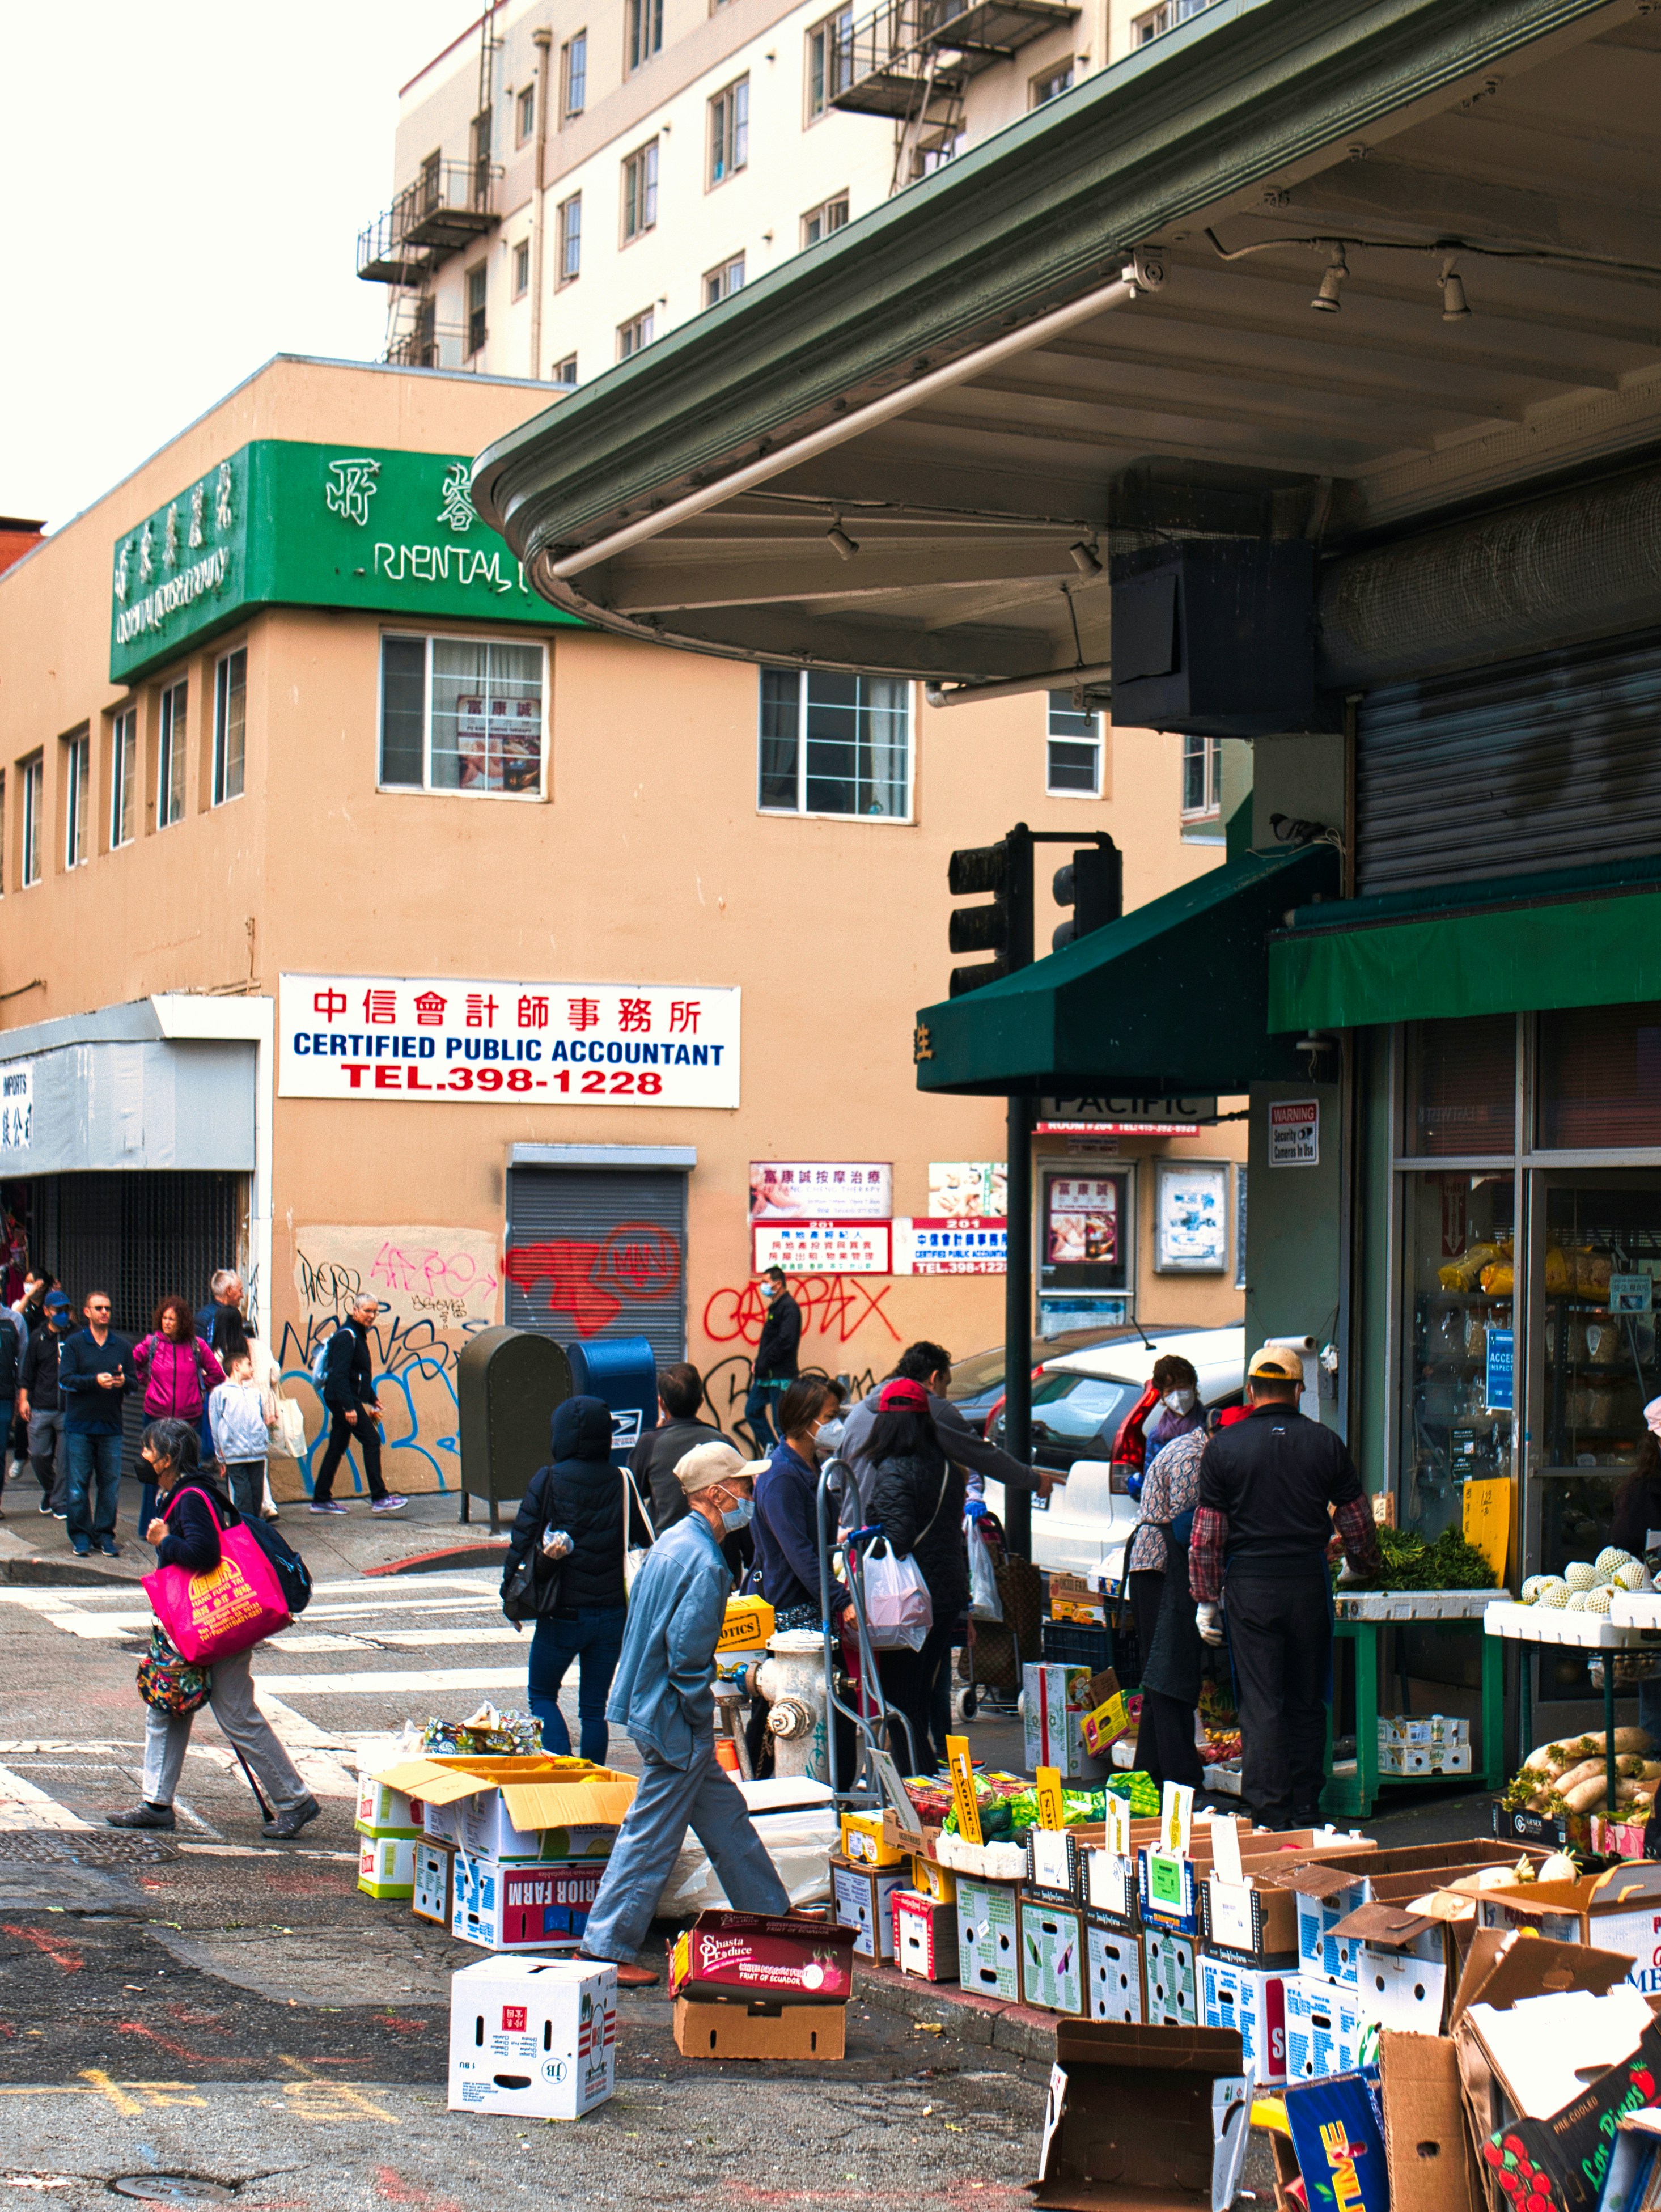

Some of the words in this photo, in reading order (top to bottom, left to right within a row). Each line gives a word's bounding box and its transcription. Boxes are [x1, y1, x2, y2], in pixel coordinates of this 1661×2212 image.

[313, 986, 702, 1035] 中信會計師事務所
[293, 1032, 435, 1059] CERTIFIED
[445, 1037, 543, 1062] PUBLIC
[551, 1040, 725, 1067] ACCOUNTANT
[340, 1063, 663, 1096] TEL.398-1228
[1273, 1105, 1315, 1123] WARNING
[1274, 1129, 1296, 1144] Security
[1274, 1146, 1297, 1159] Cameras
[1297, 1143, 1303, 1157] In
[1303, 1143, 1314, 1157] Use
[809, 1220, 834, 1228] 201
[946, 1219, 980, 1230] 201
[915, 1250, 946, 1258] CERTIFIED
[948, 1249, 970, 1258] PUBLIC
[916, 1262, 1007, 1274] TEL.398-122
[212, 1582, 231, 1597] FUNG
[231, 1575, 245, 1586] TAI
[721, 1622, 755, 1639] OTICS
[508, 1881, 552, 1906] FARM
[700, 1934, 744, 1956] Shasta
[701, 1946, 752, 1970] Produce
[739, 1971, 759, 1980] FRUIT
[769, 1974, 800, 1986] ECUADOR
[1553, 2095, 1599, 2135] PRE-COOLED
